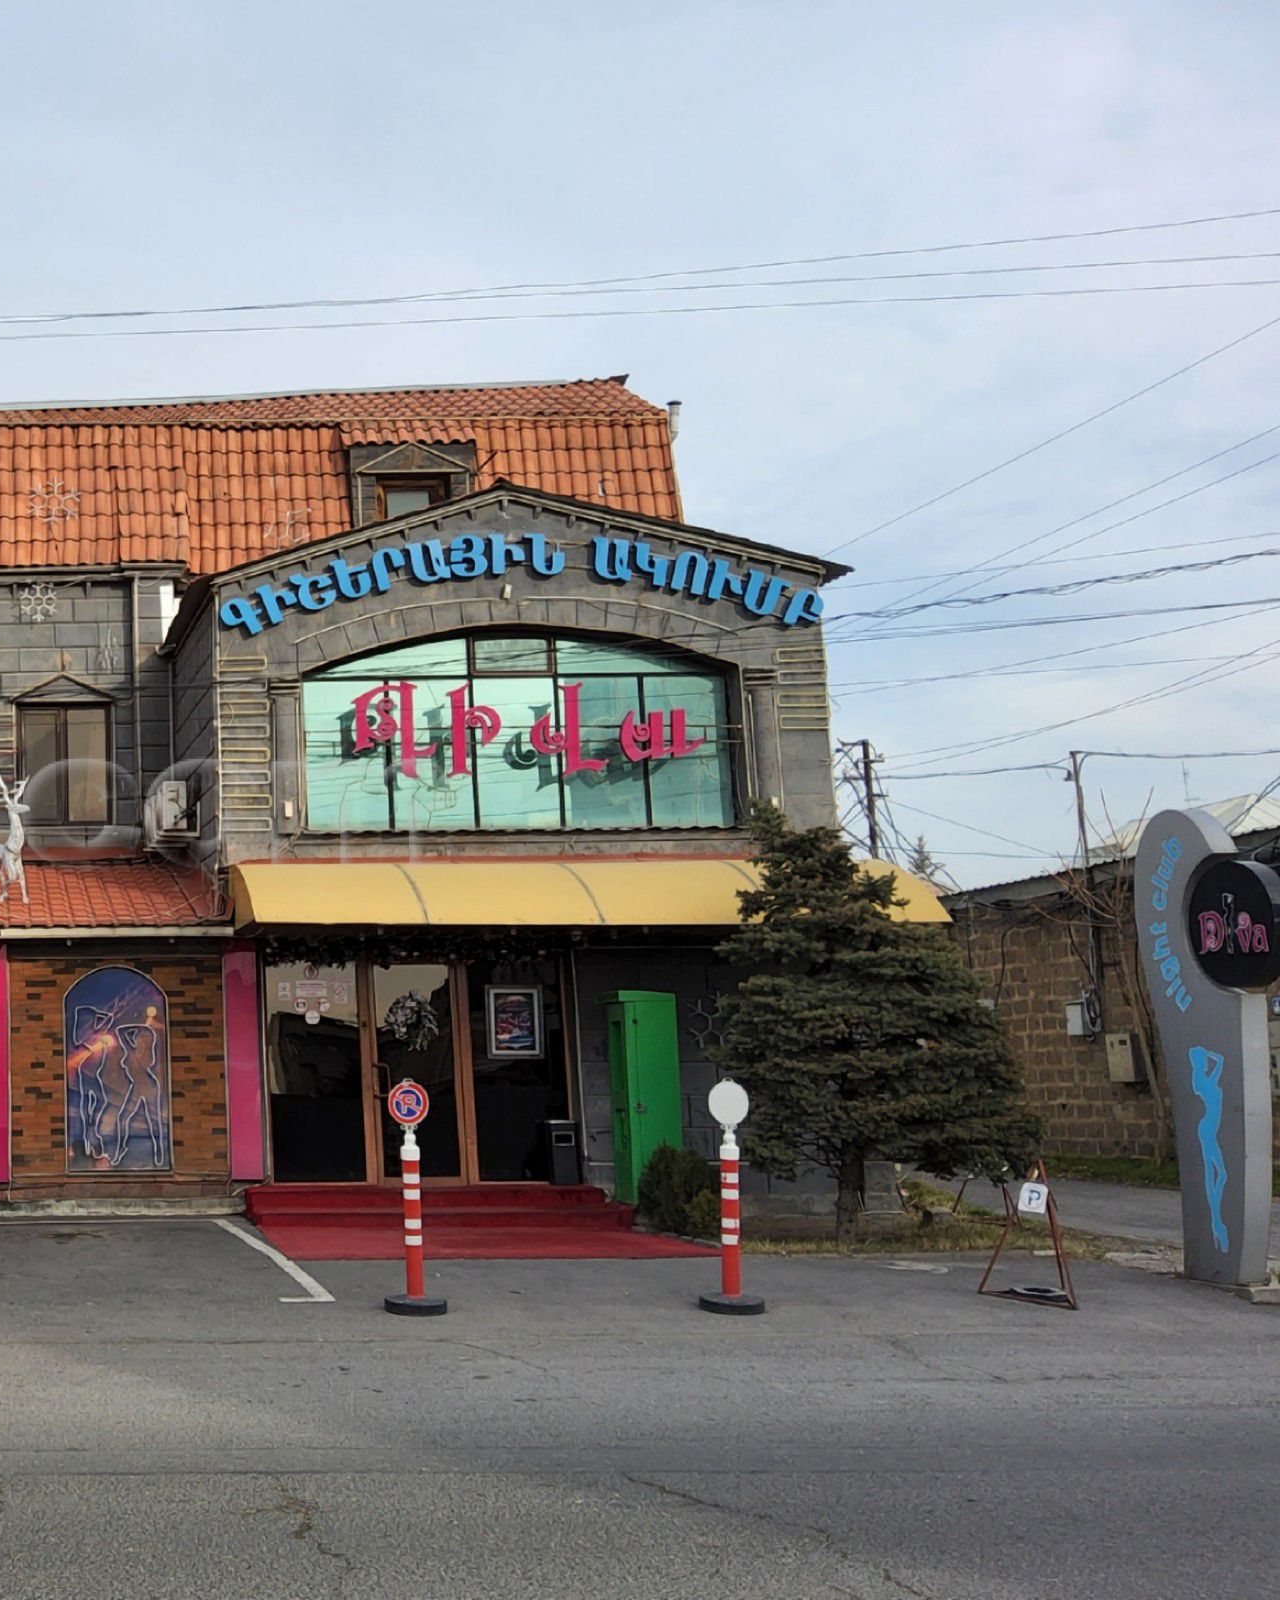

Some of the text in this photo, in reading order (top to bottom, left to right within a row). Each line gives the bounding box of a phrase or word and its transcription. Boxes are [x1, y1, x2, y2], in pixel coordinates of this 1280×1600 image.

[593, 536, 825, 626] ԱԿՈՒՄԲ
[1149, 836, 1193, 1012] night club
